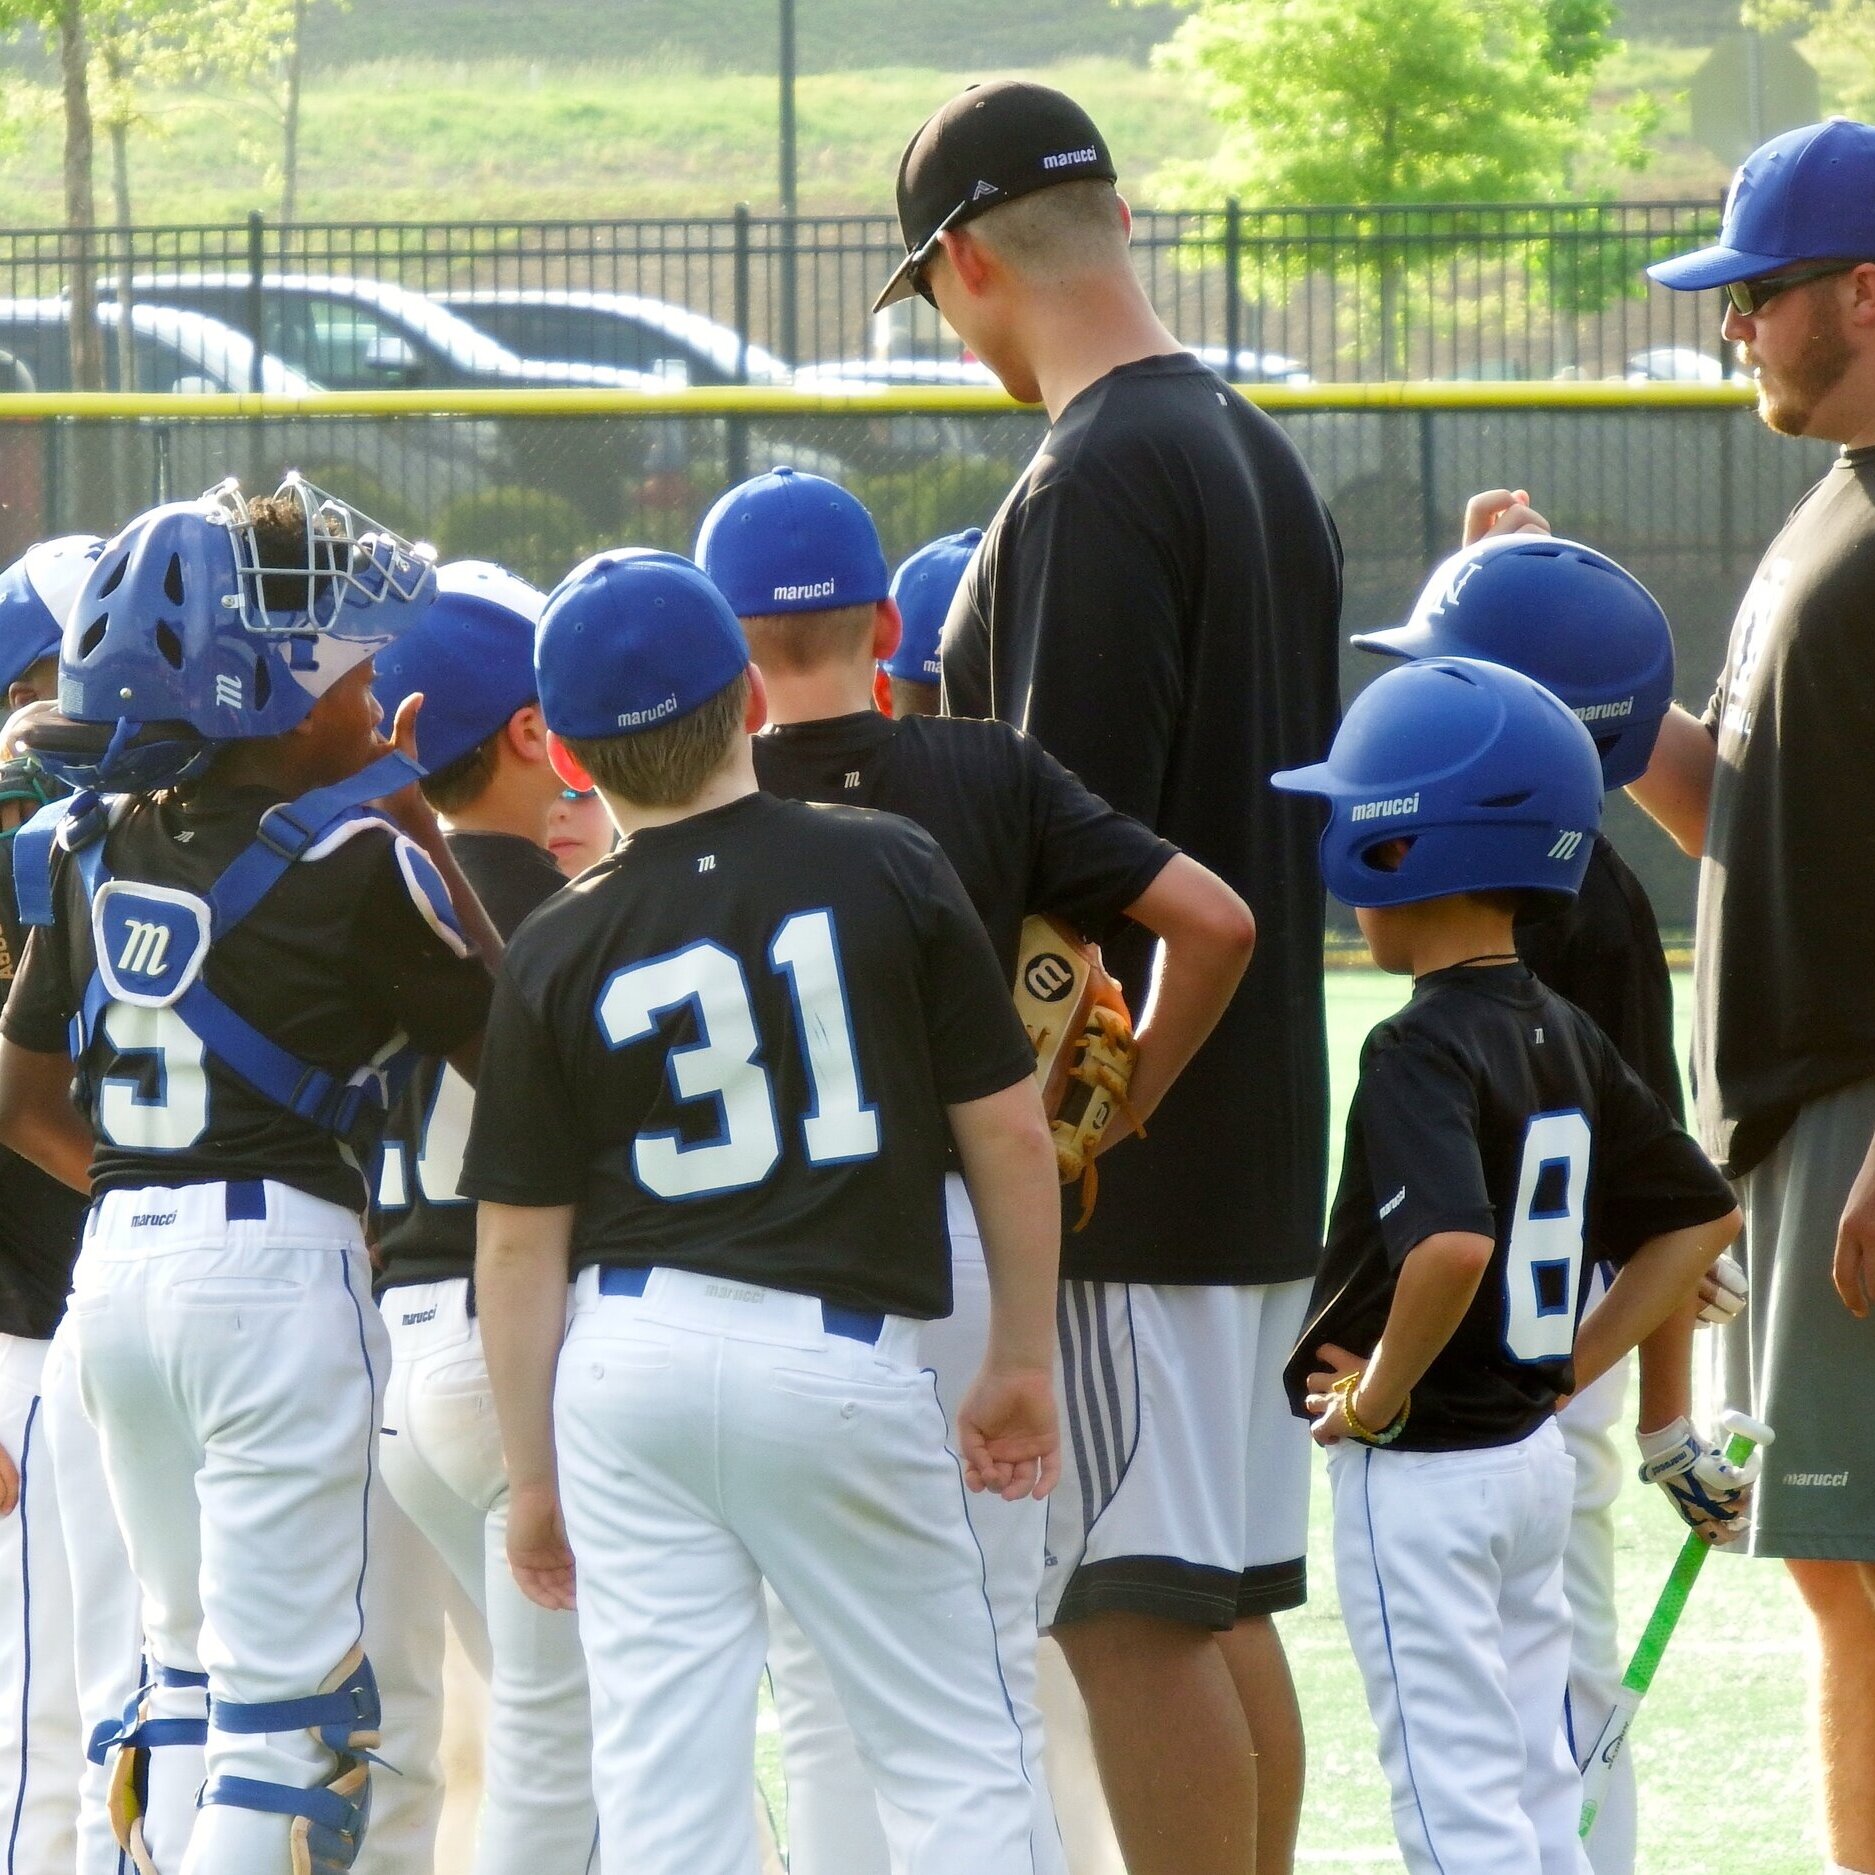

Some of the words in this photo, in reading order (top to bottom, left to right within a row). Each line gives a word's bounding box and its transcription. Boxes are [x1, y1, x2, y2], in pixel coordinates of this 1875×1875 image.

[1043, 144, 1097, 169] marucci
[773, 577, 834, 600] marucci
[617, 692, 677, 727] marucci
[1351, 791, 1420, 822] marucci
[118, 919, 170, 977] m
[596, 906, 882, 1201] 31
[130, 1209, 178, 1228] marucci
[1502, 1107, 1592, 1364] 8
[1782, 1471, 1849, 1487] marucci
